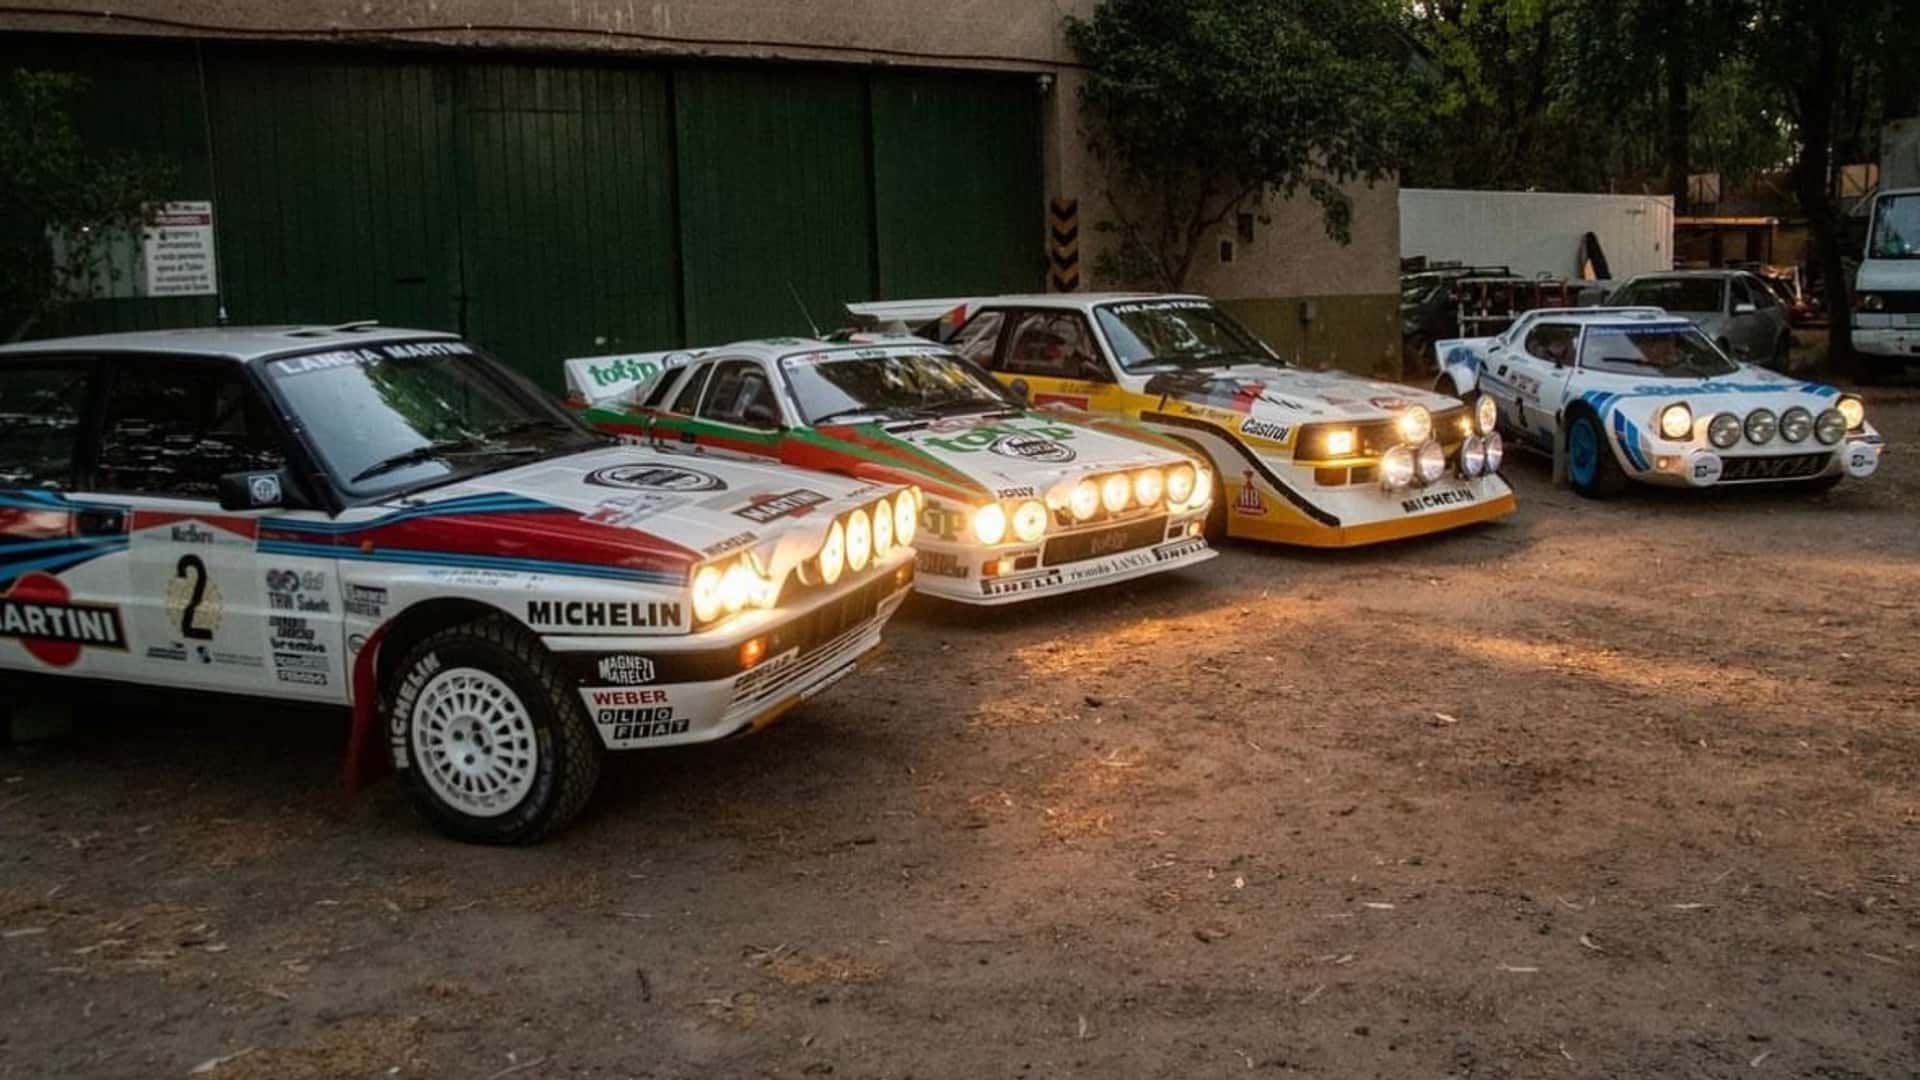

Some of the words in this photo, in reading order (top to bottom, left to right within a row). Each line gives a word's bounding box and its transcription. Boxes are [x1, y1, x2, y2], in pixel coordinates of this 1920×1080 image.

[277, 349, 383, 373] LANCIA
[383, 342, 473, 358] MARTINI
[588, 360, 657, 386] totip
[1241, 418, 1289, 441] Castrol
[998, 487, 1035, 499] JOLLY
[1401, 490, 1474, 513] MICHELIN
[981, 570, 1064, 594] PIRELLI
[177, 554, 213, 640] 2
[528, 601, 682, 626] MICHELIN
[391, 651, 441, 768] MICHELIN
[594, 690, 668, 706] WEBER
[599, 707, 672, 724] OLIO
[614, 719, 690, 739] FIAT
